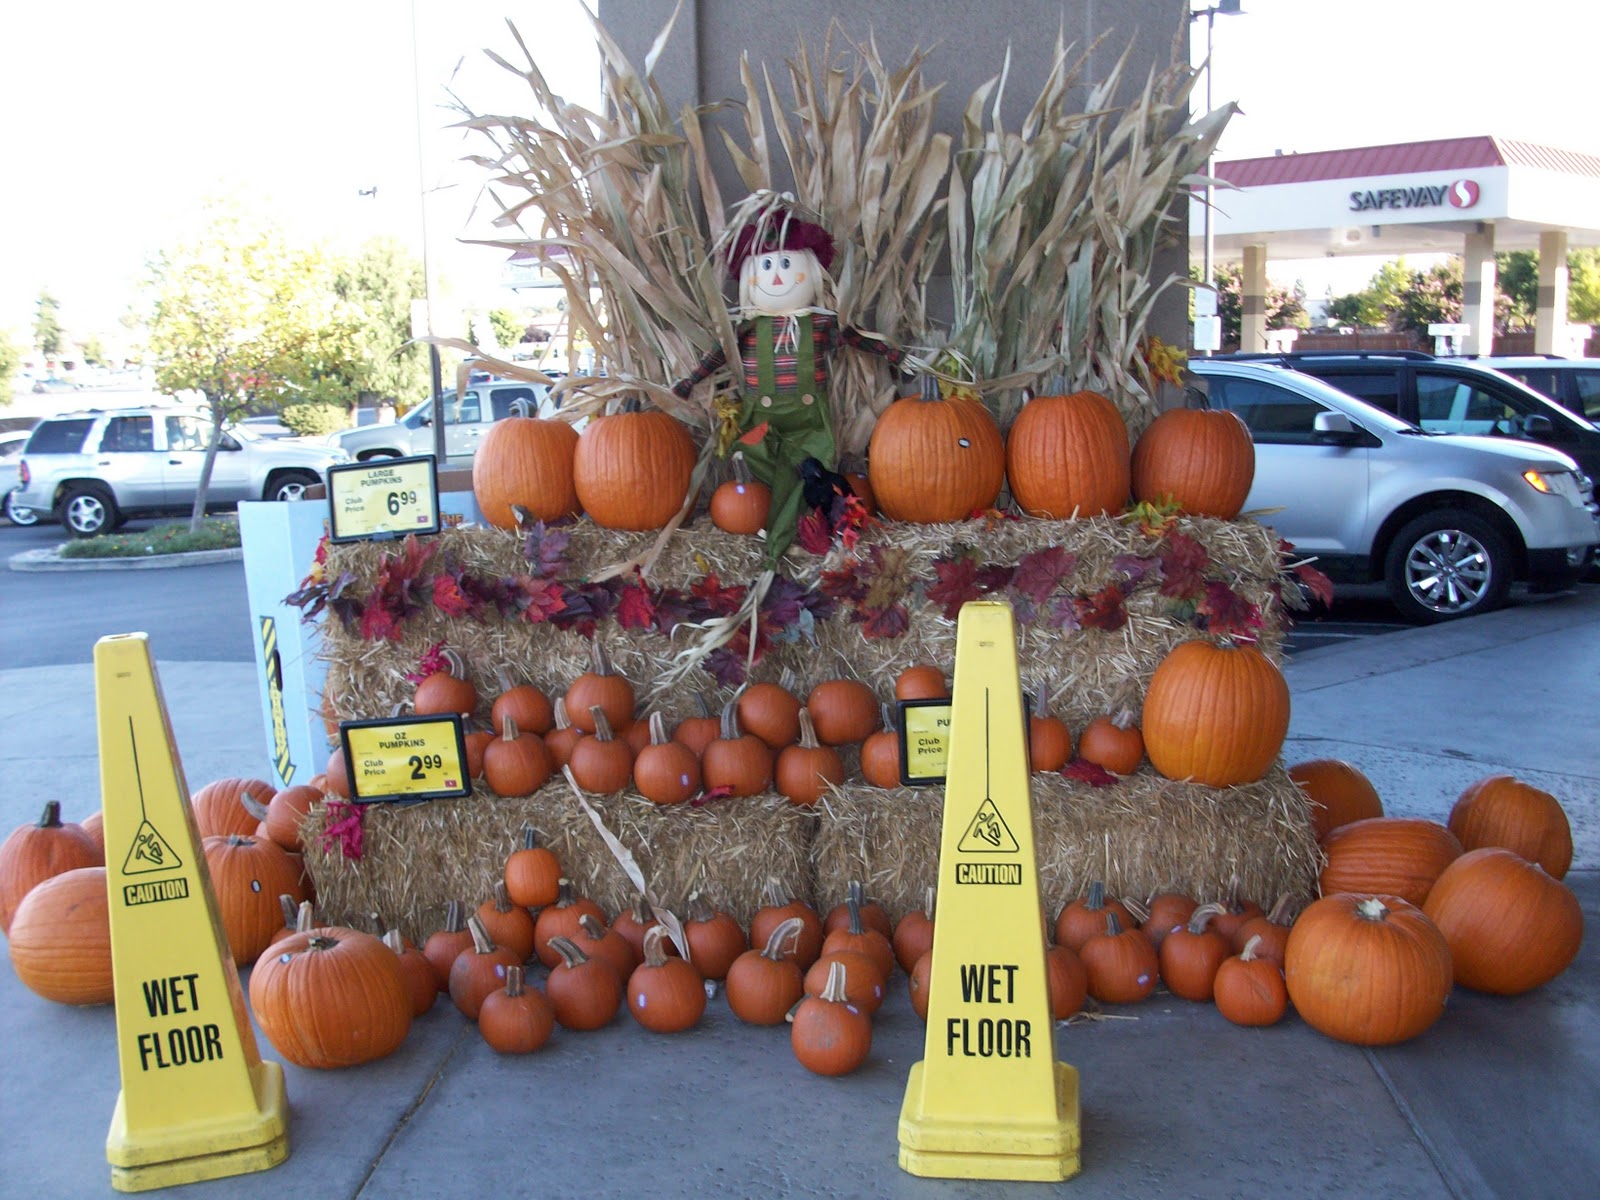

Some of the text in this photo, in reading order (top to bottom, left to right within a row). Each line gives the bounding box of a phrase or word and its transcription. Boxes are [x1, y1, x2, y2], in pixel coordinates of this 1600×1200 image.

[1350, 185, 1448, 211] SAFEWAY
[368, 469, 394, 478] LARGE
[360, 476, 403, 487] PUMPKINS
[345, 496, 363, 505] Club
[344, 505, 365, 513] Price
[937, 719, 952, 727] PU
[394, 732, 407, 740] OZ
[378, 739, 426, 749] PUMPKINS
[918, 738, 940, 746] Club
[918, 746, 943, 755] Price
[364, 760, 384, 768] Club
[364, 769, 386, 777] Price
[957, 864, 1020, 884] CAUTION
[125, 879, 187, 905] CAUTION
[960, 964, 1019, 1004] WET
[142, 973, 200, 1018] WET
[947, 1018, 1031, 1058] FLOOR
[137, 1023, 224, 1071] FLOOR
